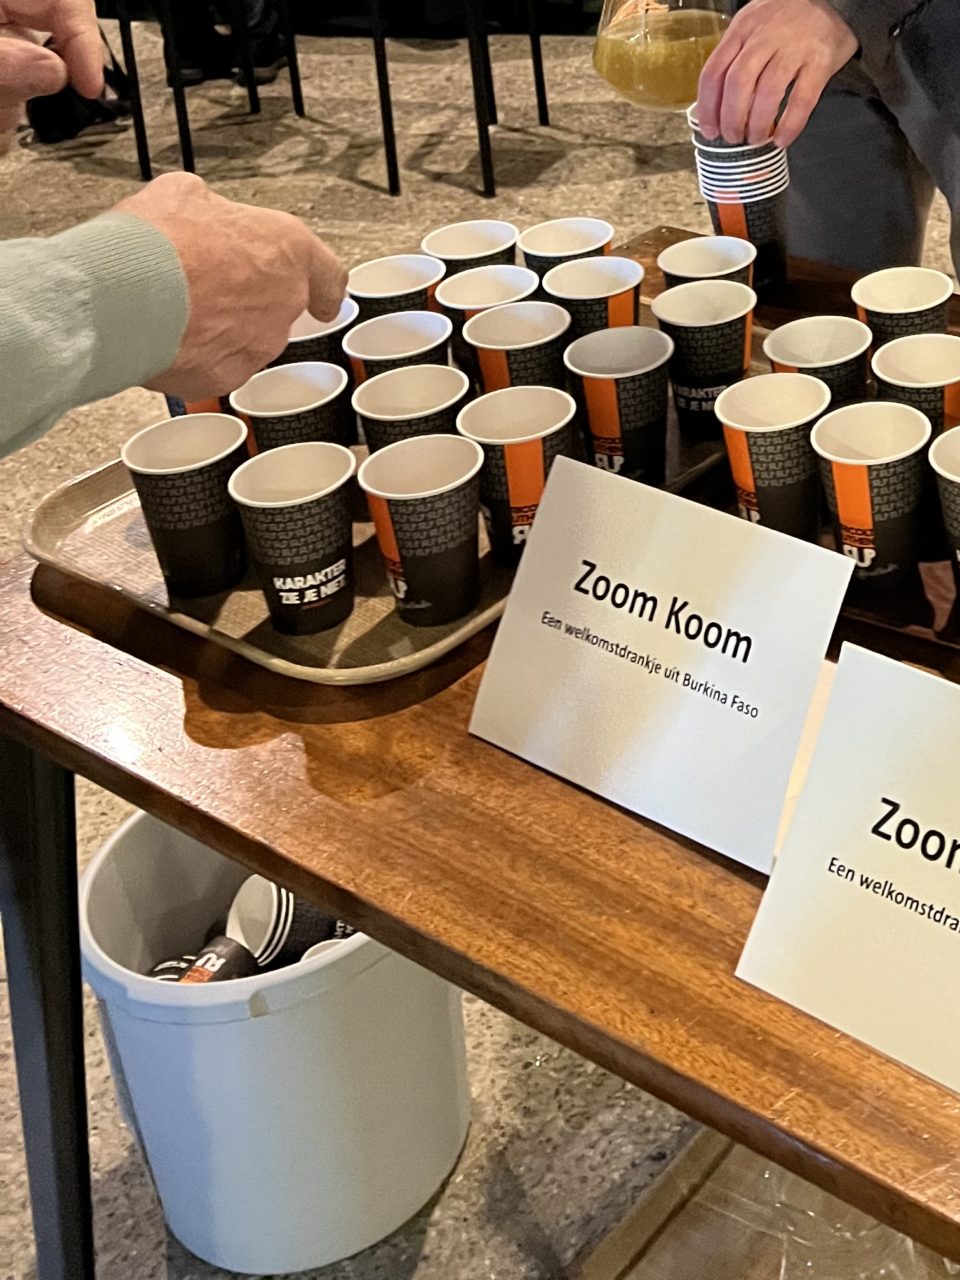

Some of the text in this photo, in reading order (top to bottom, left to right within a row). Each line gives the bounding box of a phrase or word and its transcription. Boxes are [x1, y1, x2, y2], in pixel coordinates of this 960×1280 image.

[273, 558, 346, 590] KARAKTER
[303, 588, 319, 603] JE
[573, 559, 753, 664] Zoom Koom
[541, 610, 759, 719] Een welkomstdrankje uit Burkina Faso
[827, 856, 856, 883] Een
